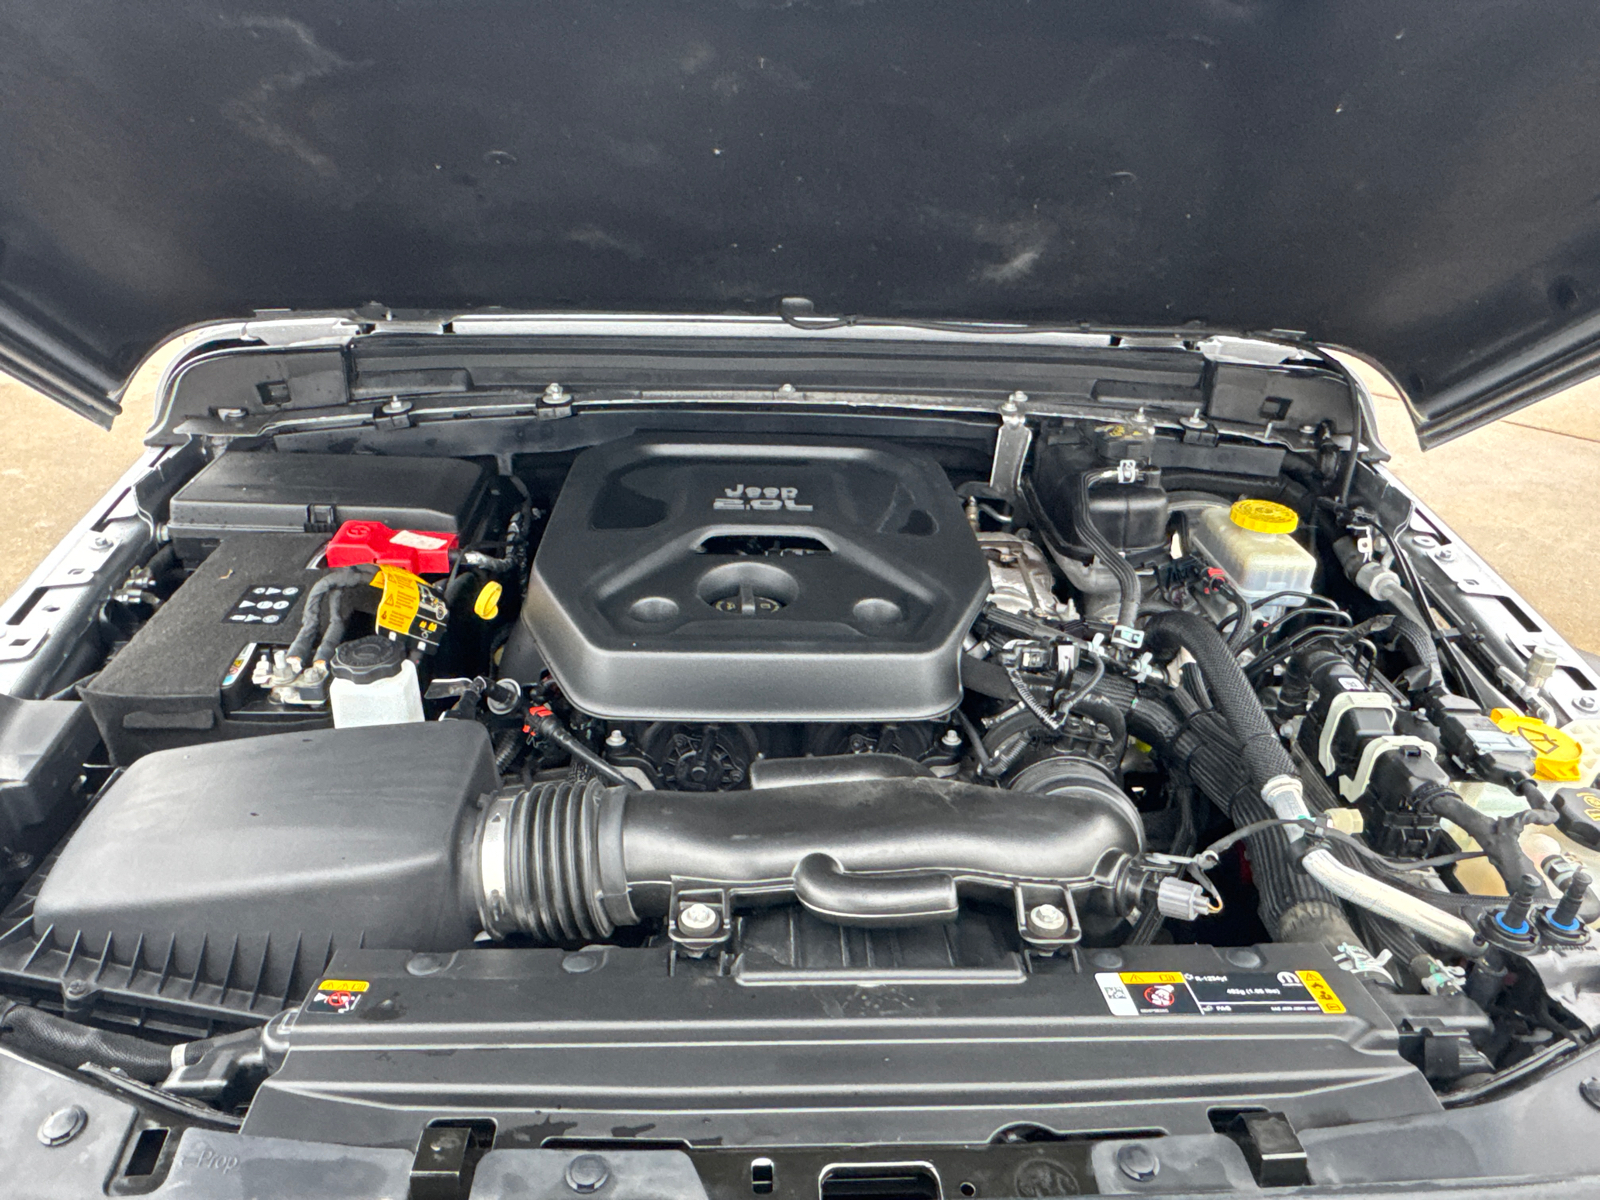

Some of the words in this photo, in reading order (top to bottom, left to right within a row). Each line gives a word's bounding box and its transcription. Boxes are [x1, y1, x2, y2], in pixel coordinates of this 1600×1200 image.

[724, 483, 799, 500] Jeep
[713, 498, 814, 511] 2.0L
[196, 1150, 239, 1175] Prop
